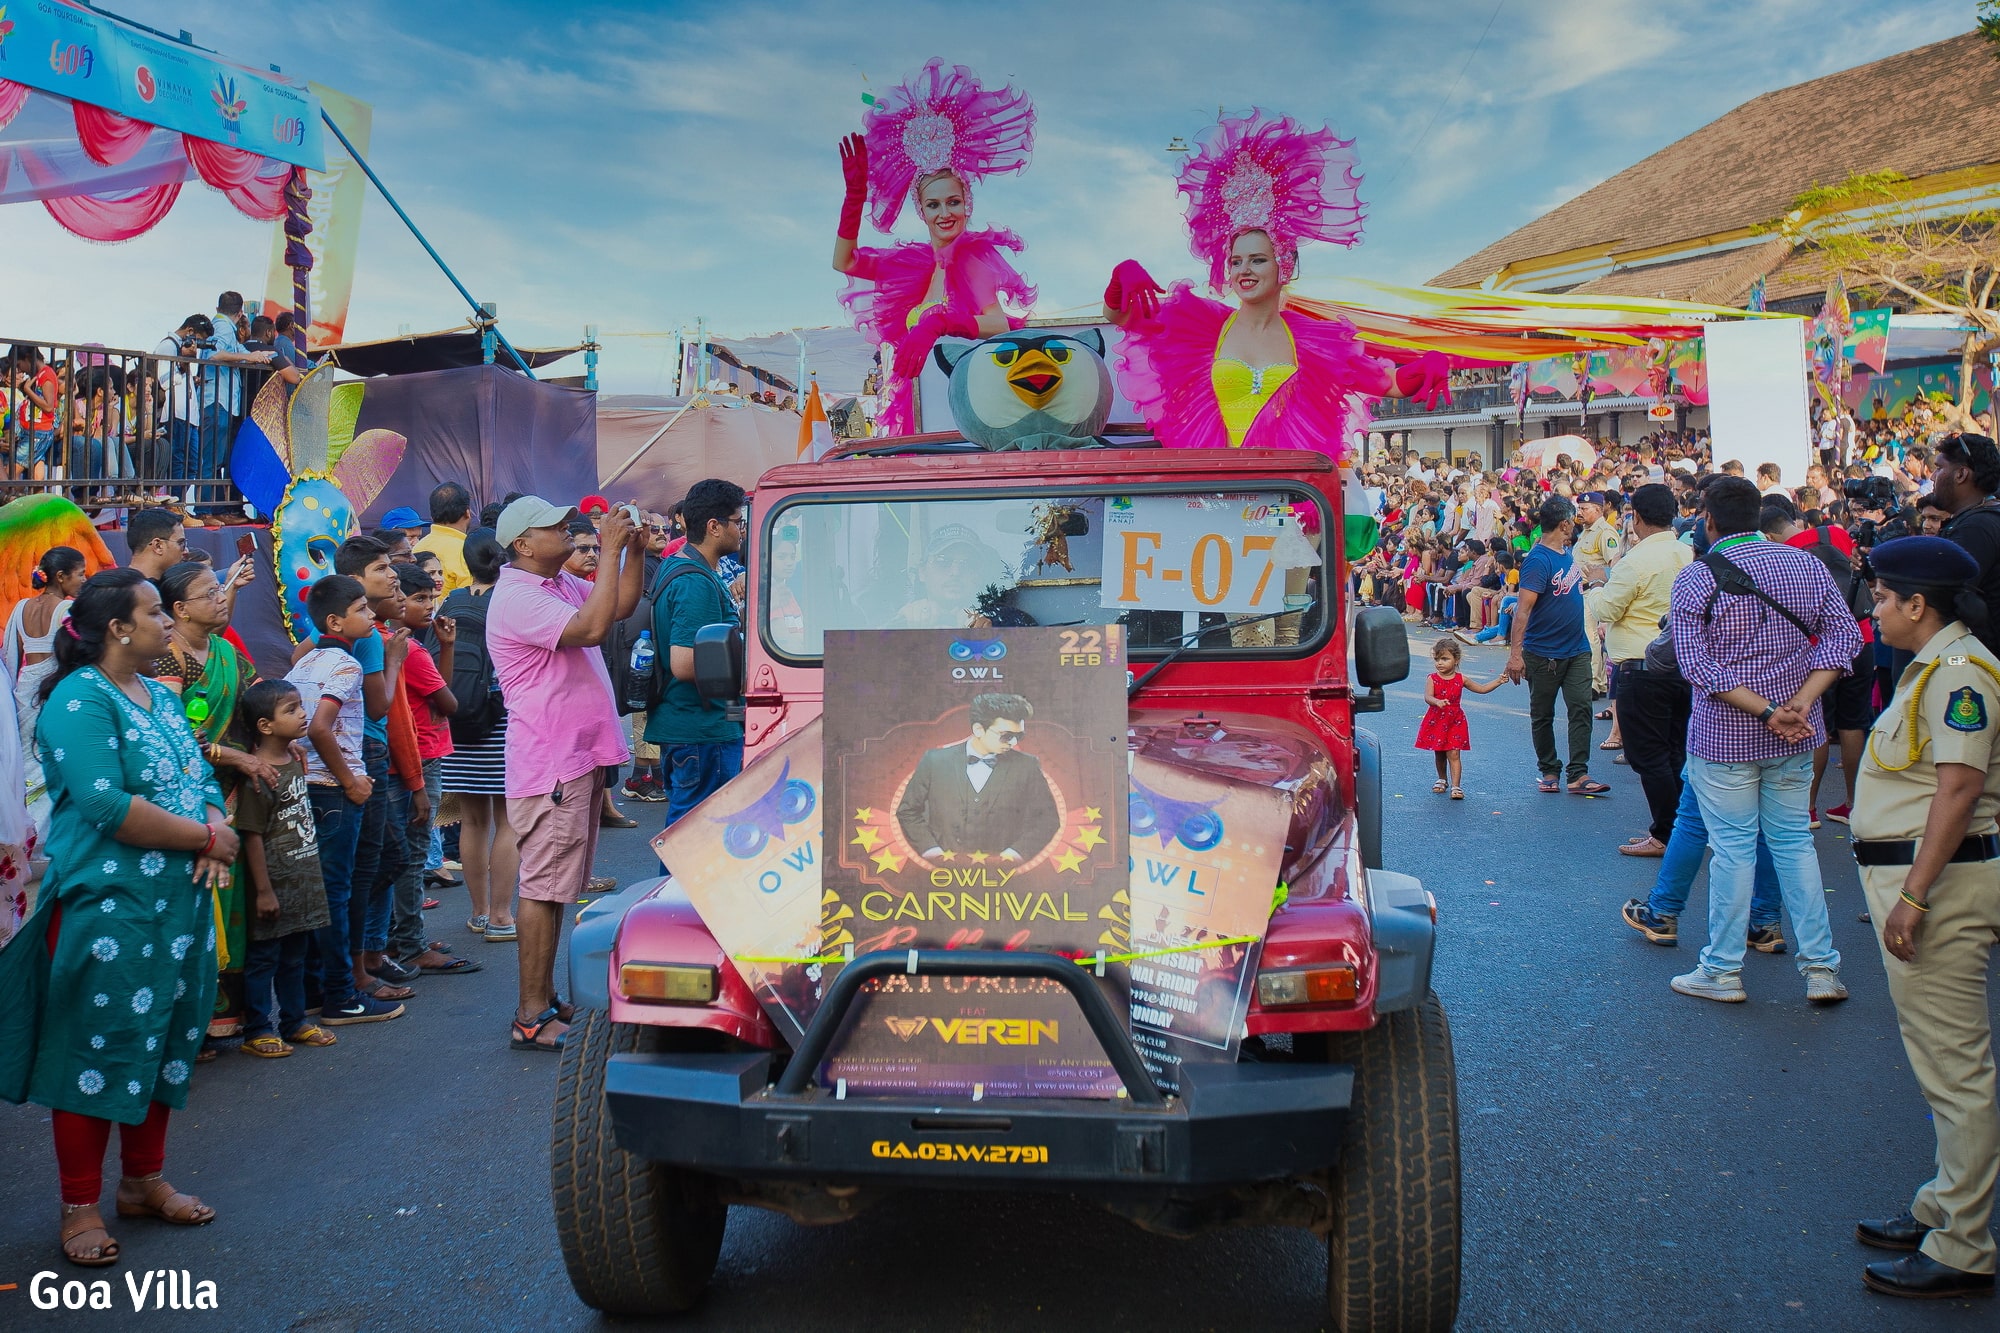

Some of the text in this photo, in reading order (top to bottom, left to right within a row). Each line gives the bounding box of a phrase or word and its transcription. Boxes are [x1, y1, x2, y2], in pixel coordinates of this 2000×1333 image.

[38, 3, 83, 25] GOA TOURISM
[263, 84, 298, 100] GOA TOURISM
[1656, 406, 1667, 416] VIP
[1188, 501, 1207, 509] 202
[1117, 531, 1278, 606] F-07
[1059, 630, 1102, 653] 22
[1060, 654, 1101, 666] FEB
[952, 667, 1003, 679] OWL
[759, 829, 823, 893] OW
[930, 868, 1016, 887] OWLY
[1128, 855, 1205, 896] WL
[861, 891, 1089, 921] CARNIVAL
[1136, 943, 1204, 974] THURSDAY
[1131, 964, 1199, 996] NAL FRIDAY
[960, 1007, 986, 1016] FEAT
[1159, 991, 1198, 1015] SATURDAY
[1060, 1059, 1081, 1068] ANY
[863, 1080, 917, 1088] RESERVATION
[1079, 1070, 1103, 1078] COST
[871, 1140, 1049, 1163] GA.03.W.2791
